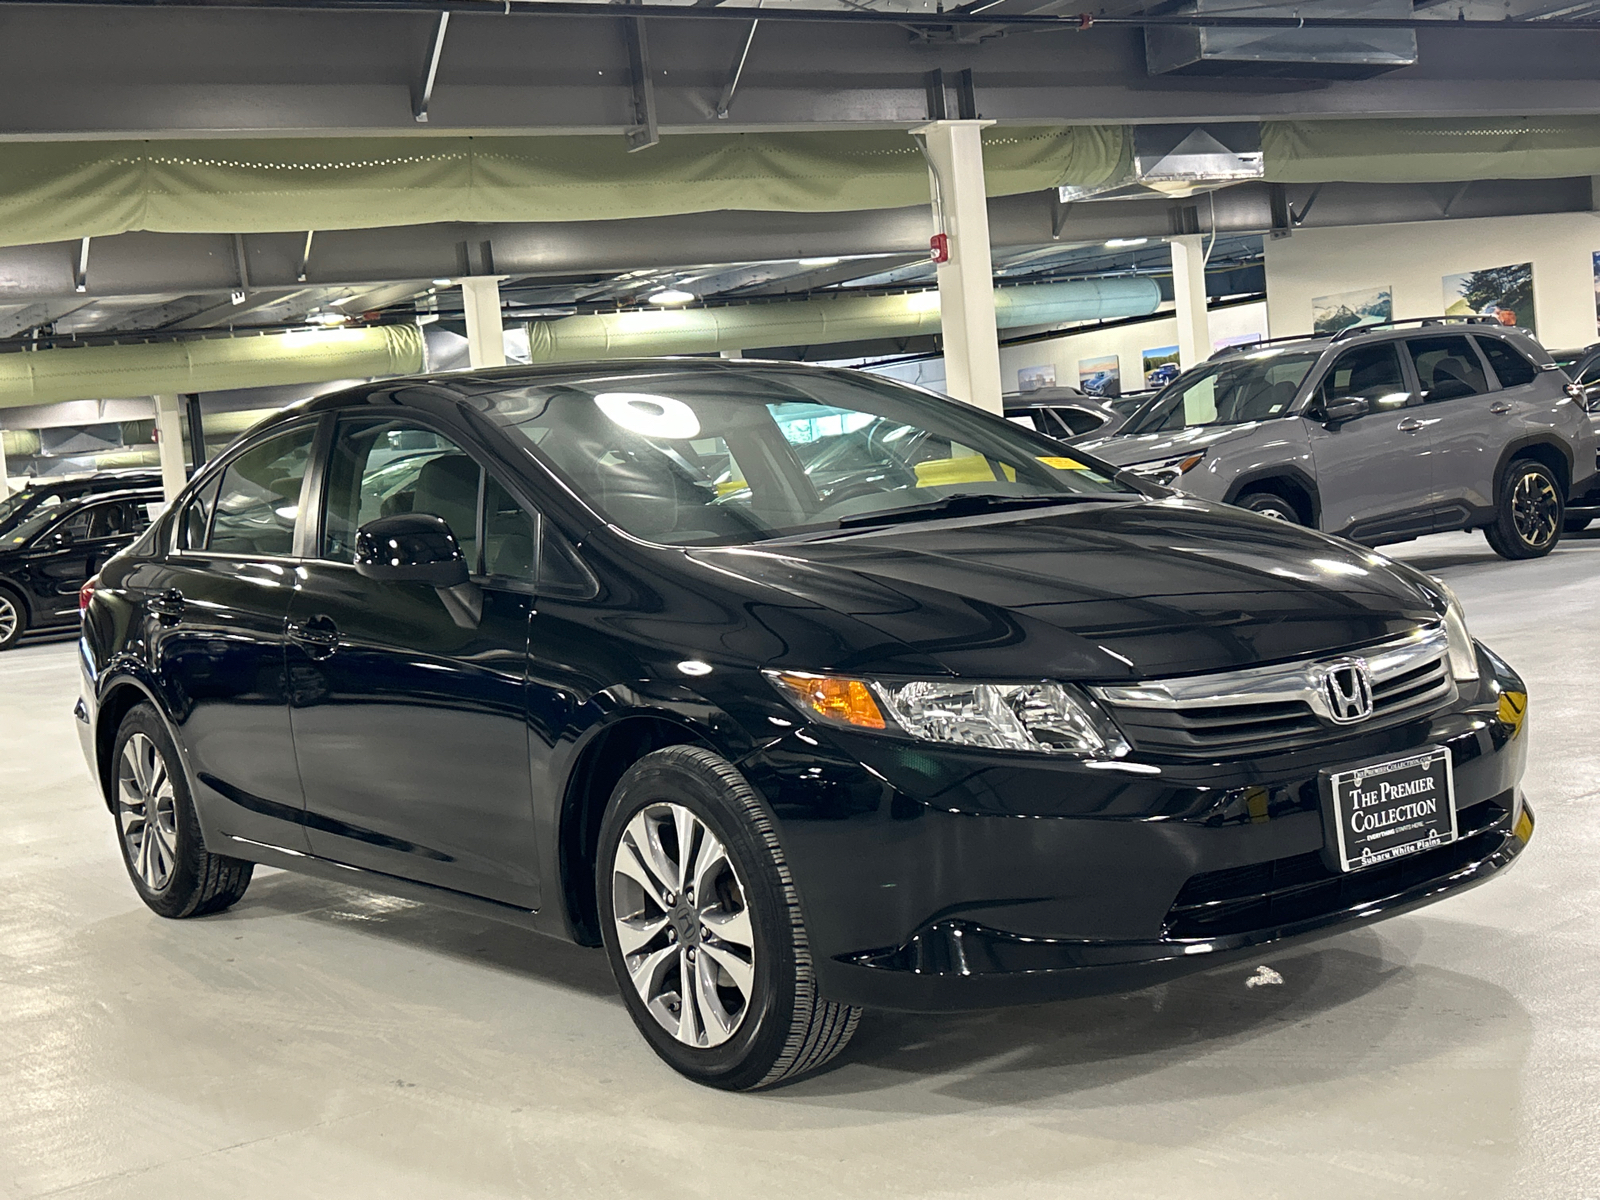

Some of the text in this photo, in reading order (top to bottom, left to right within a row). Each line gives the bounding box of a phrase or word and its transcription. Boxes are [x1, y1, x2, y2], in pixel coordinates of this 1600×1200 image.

[1349, 776, 1435, 810] THE PREMIER
[1351, 798, 1437, 833] COLLECTION
[1361, 837, 1442, 866] Subaru White Plains
